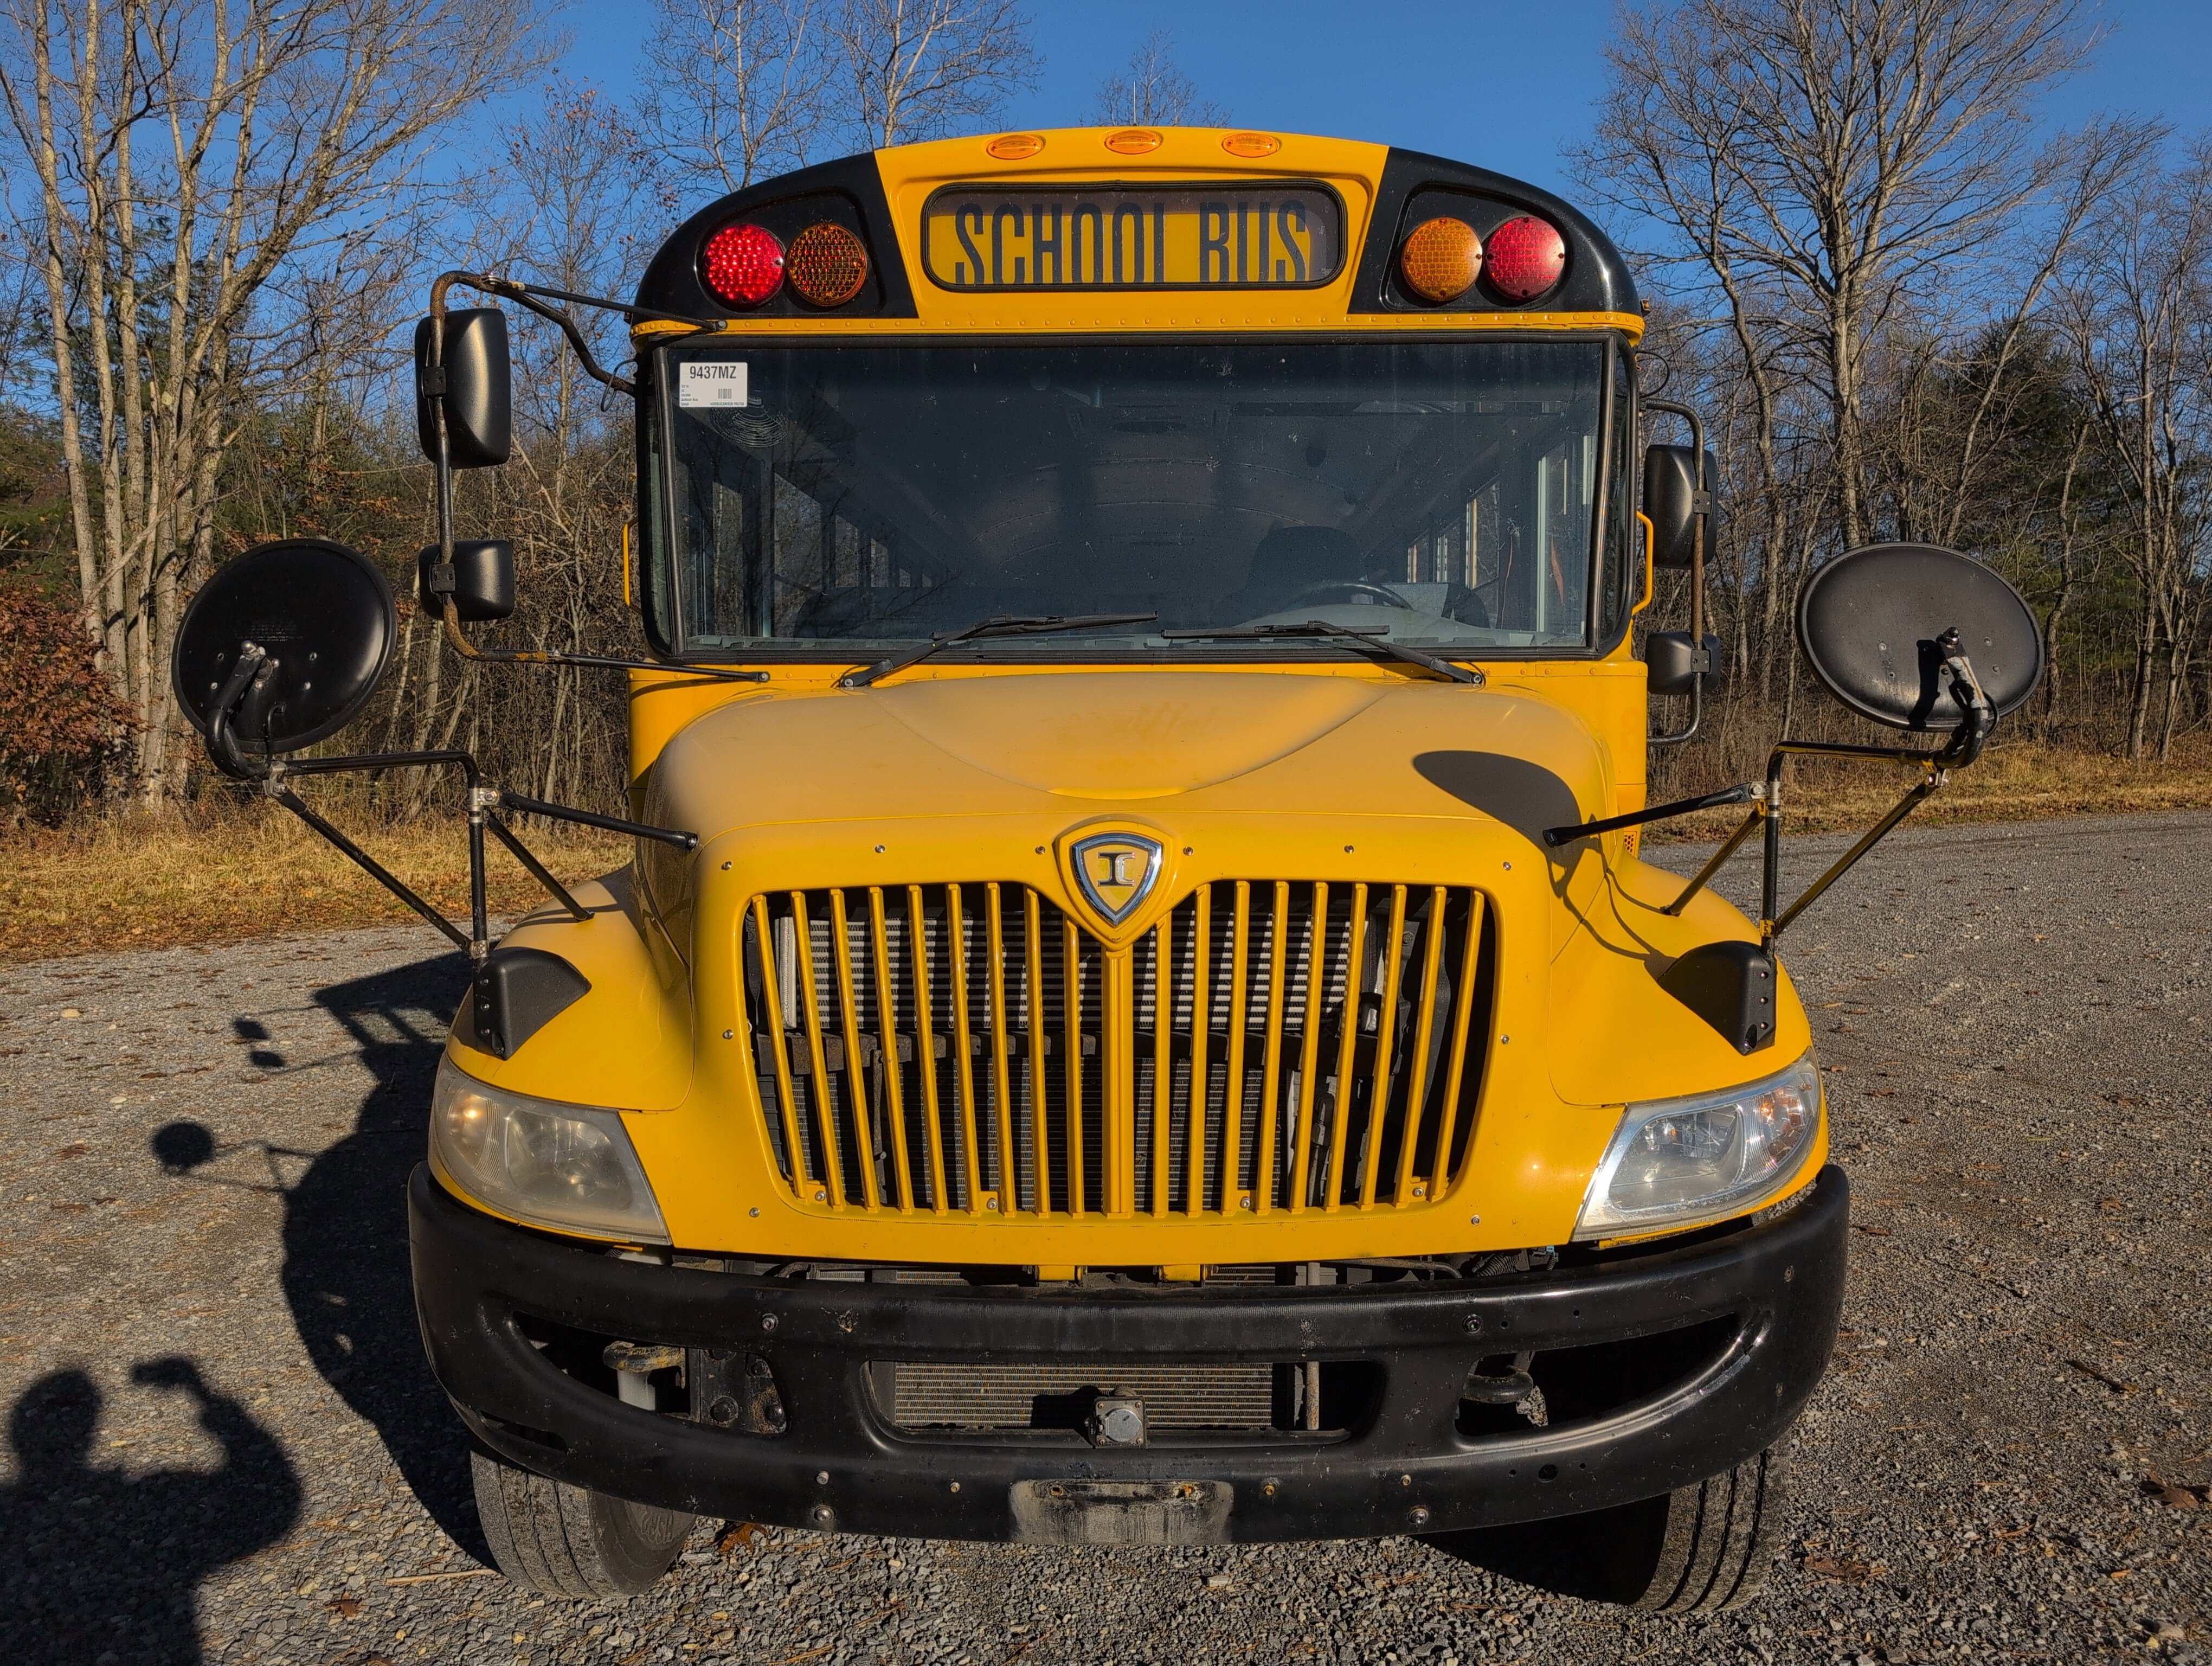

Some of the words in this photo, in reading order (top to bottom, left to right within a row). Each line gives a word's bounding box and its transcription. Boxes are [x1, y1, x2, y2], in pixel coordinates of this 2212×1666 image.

[955, 201, 1165, 284] SCHOOL
[1199, 199, 1307, 283] BUS
[690, 366, 737, 379] 9437MZ
